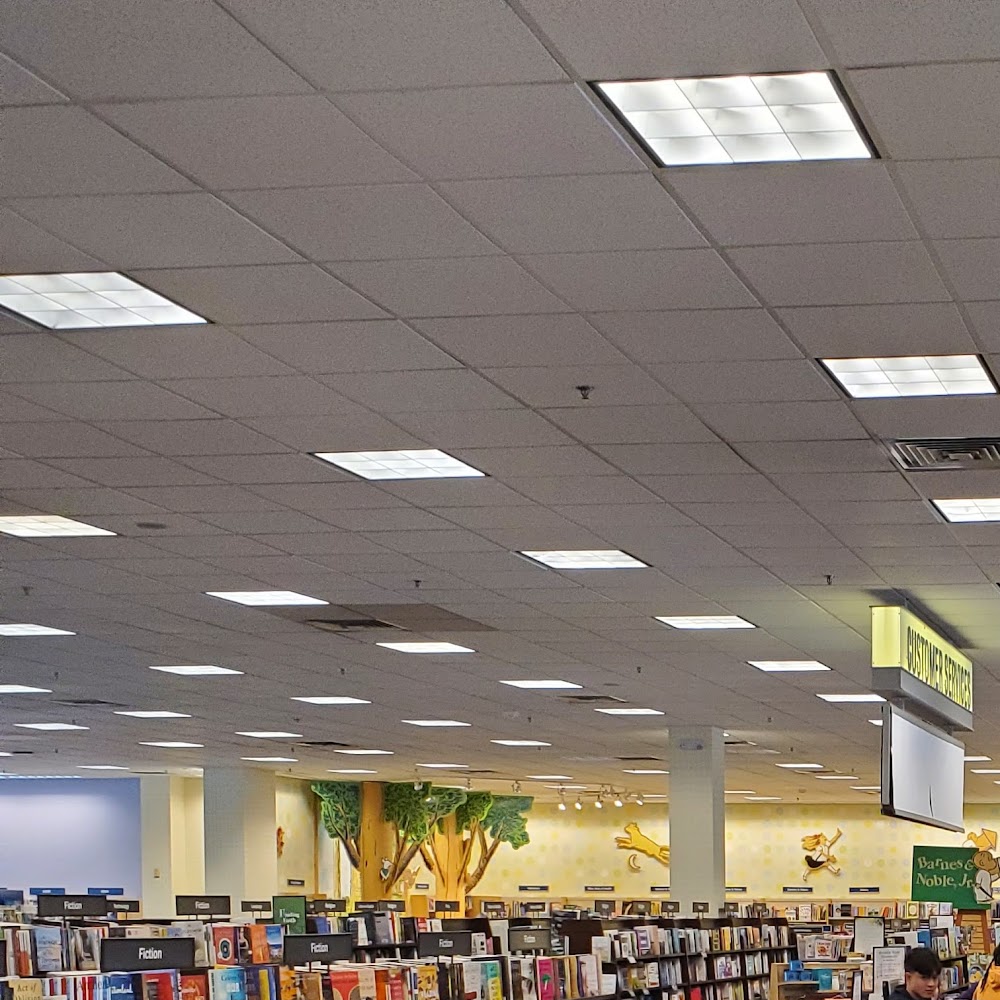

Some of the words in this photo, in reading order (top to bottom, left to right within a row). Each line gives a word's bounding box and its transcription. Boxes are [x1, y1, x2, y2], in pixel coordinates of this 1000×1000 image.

[907, 625, 943, 692] CUSTOMER
[944, 653, 971, 709] SERVICES
[917, 857, 963, 870] Barnes
[964, 858, 974, 871] &
[64, 901, 82, 910] Fiction
[195, 901, 210, 909] Fiction
[139, 947, 162, 960] Fiction
[310, 942, 328, 953] Fiction
